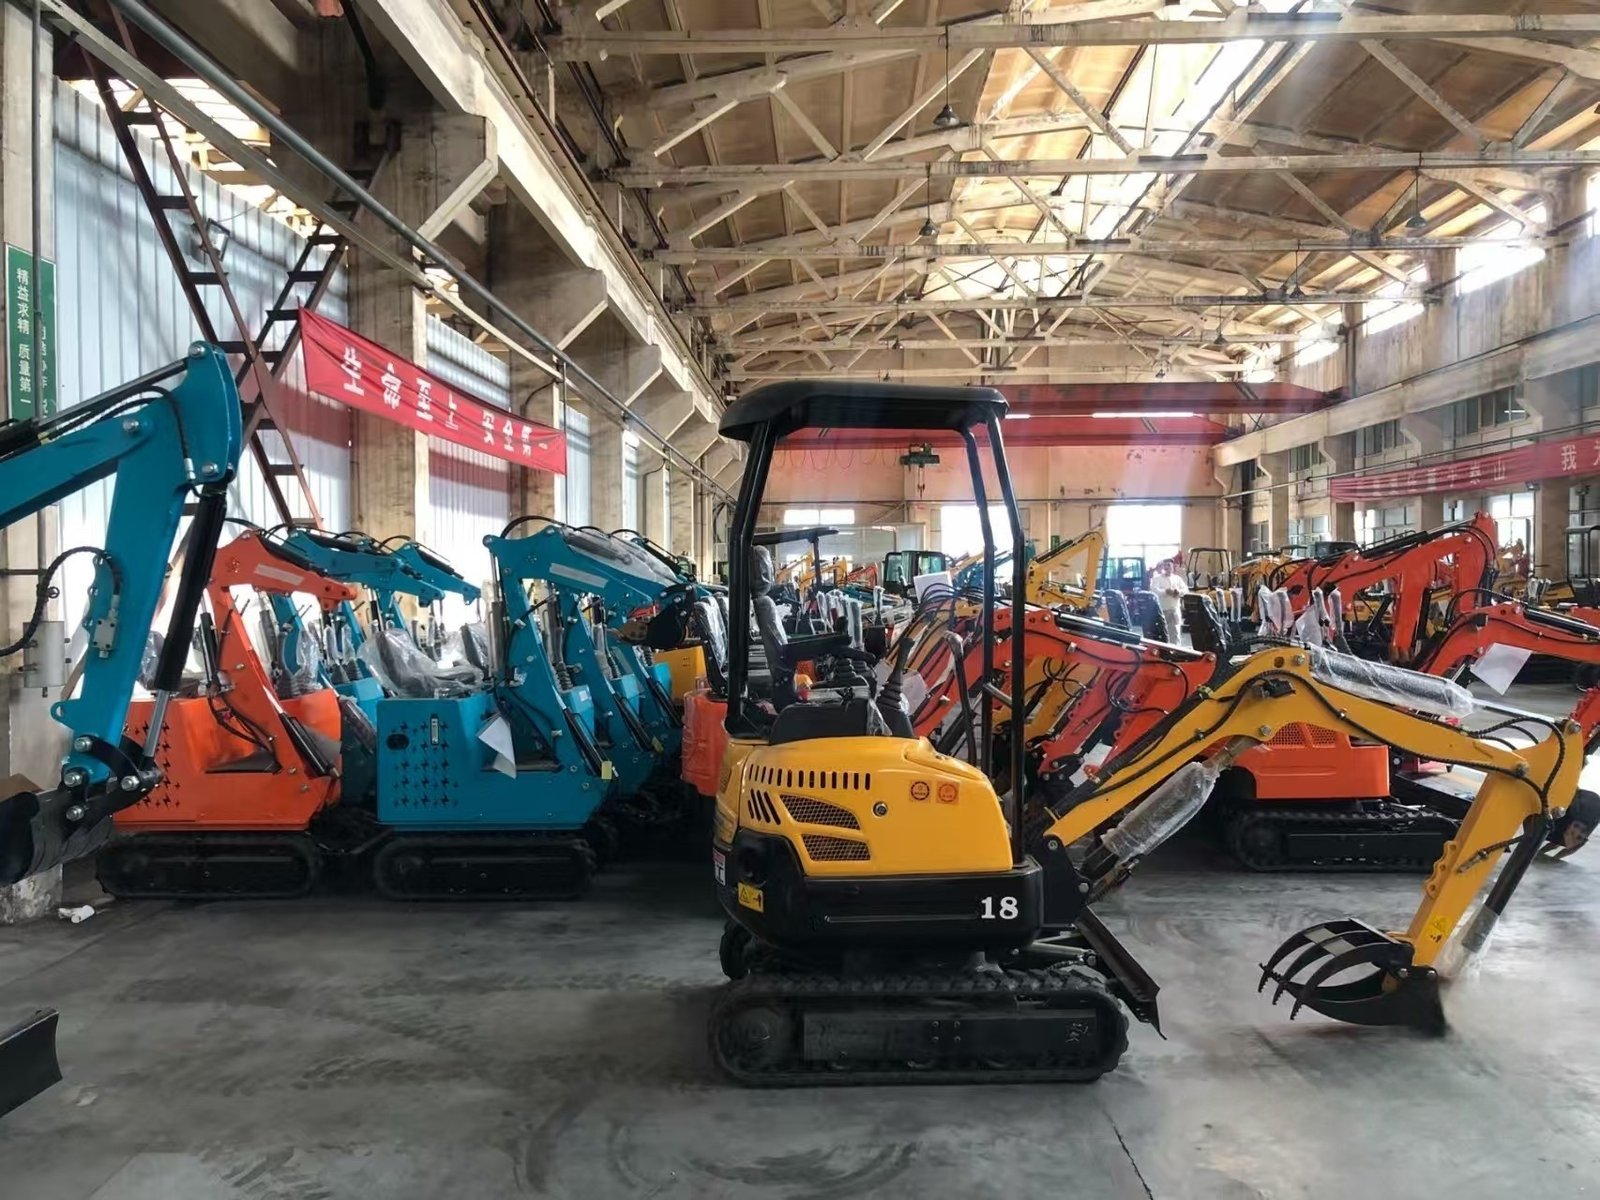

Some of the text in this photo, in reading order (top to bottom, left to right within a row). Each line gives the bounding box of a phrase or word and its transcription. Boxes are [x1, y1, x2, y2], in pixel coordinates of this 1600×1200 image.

[18, 344, 32, 404] 质量第一
[340, 345, 459, 430] 生命至上
[1357, 456, 1506, 497] 重于泰山
[981, 896, 1019, 920] 18
